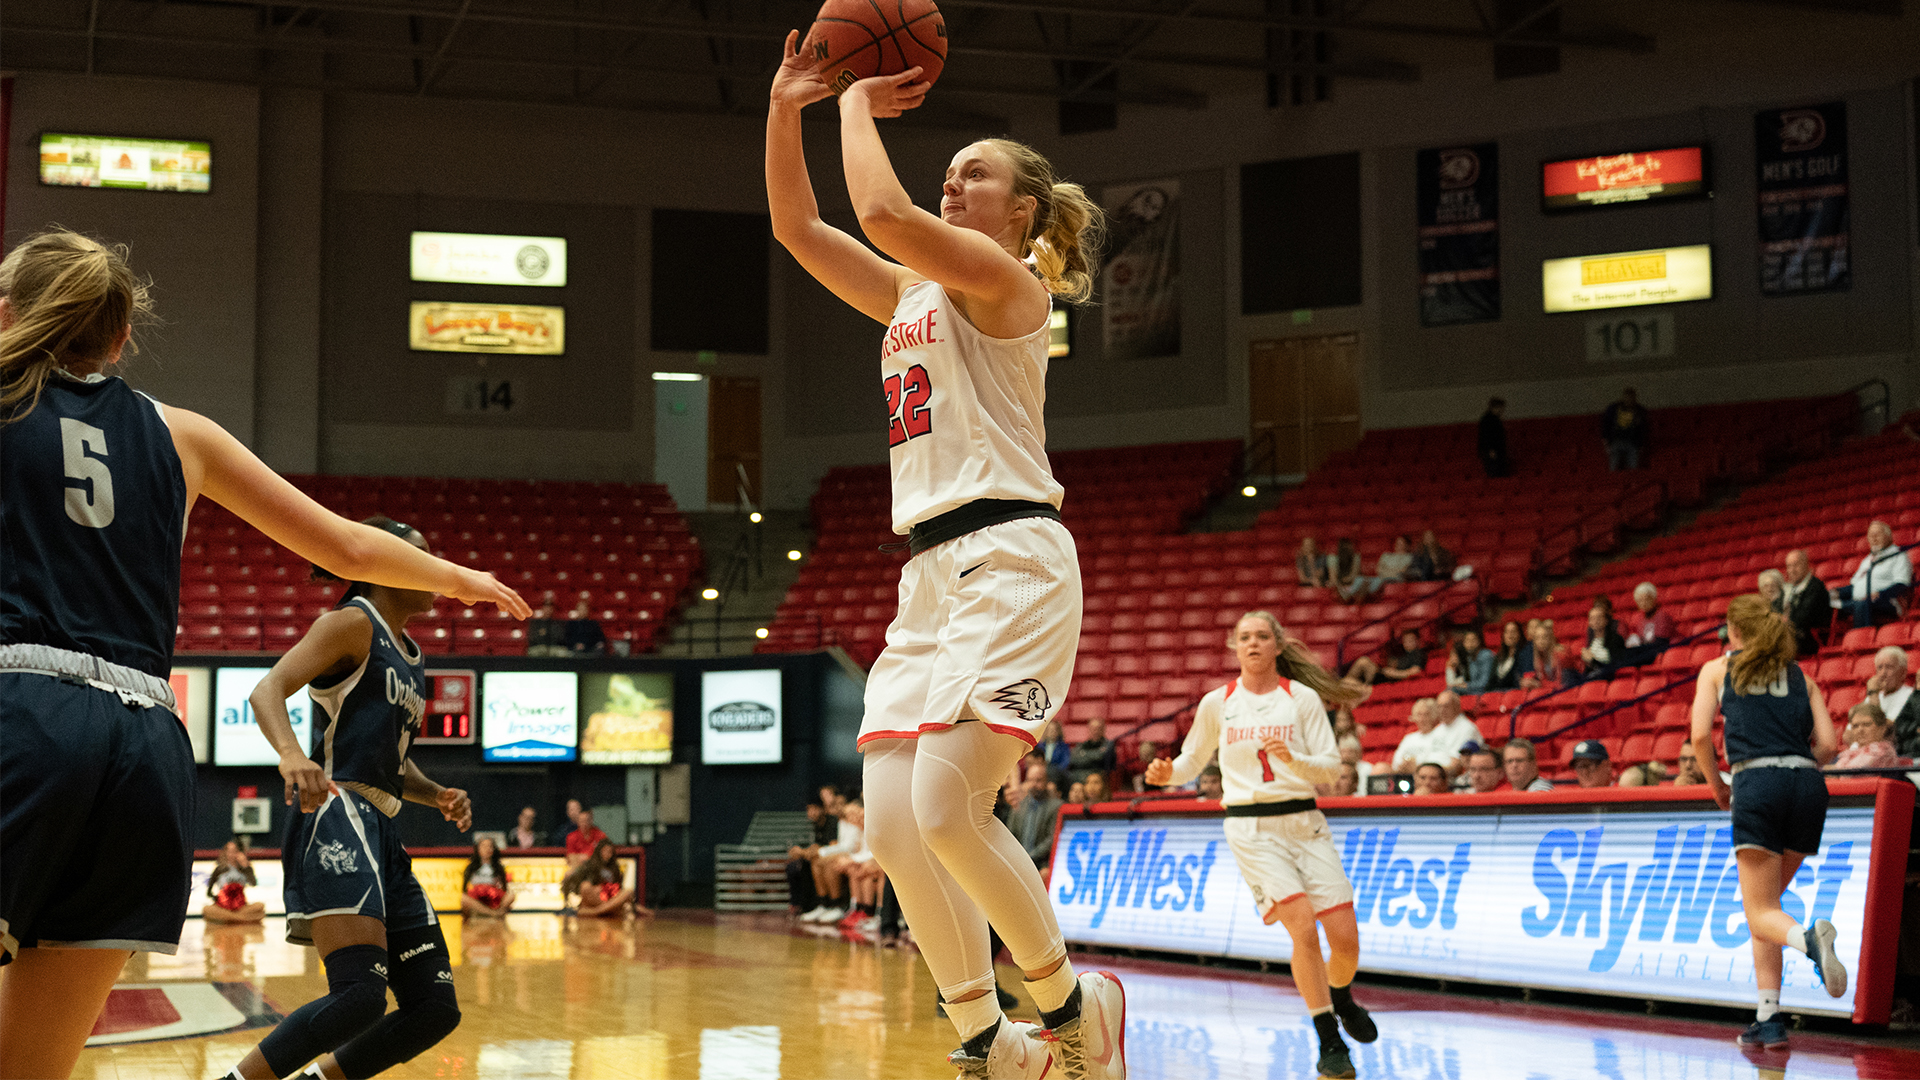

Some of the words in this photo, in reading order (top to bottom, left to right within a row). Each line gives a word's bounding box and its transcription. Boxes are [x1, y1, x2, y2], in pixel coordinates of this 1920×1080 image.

[1586, 260, 1662, 282] InfoWest
[889, 308, 938, 353] STATE
[1598, 319, 1660, 354] 101
[884, 363, 932, 448] 22
[59, 417, 115, 529] 5
[443, 715, 468, 737] 11
[1227, 726, 1255, 745] DIXIE
[1258, 724, 1294, 742] STATE
[1257, 748, 1275, 783] 1
[1059, 828, 1218, 929] SkyWest
